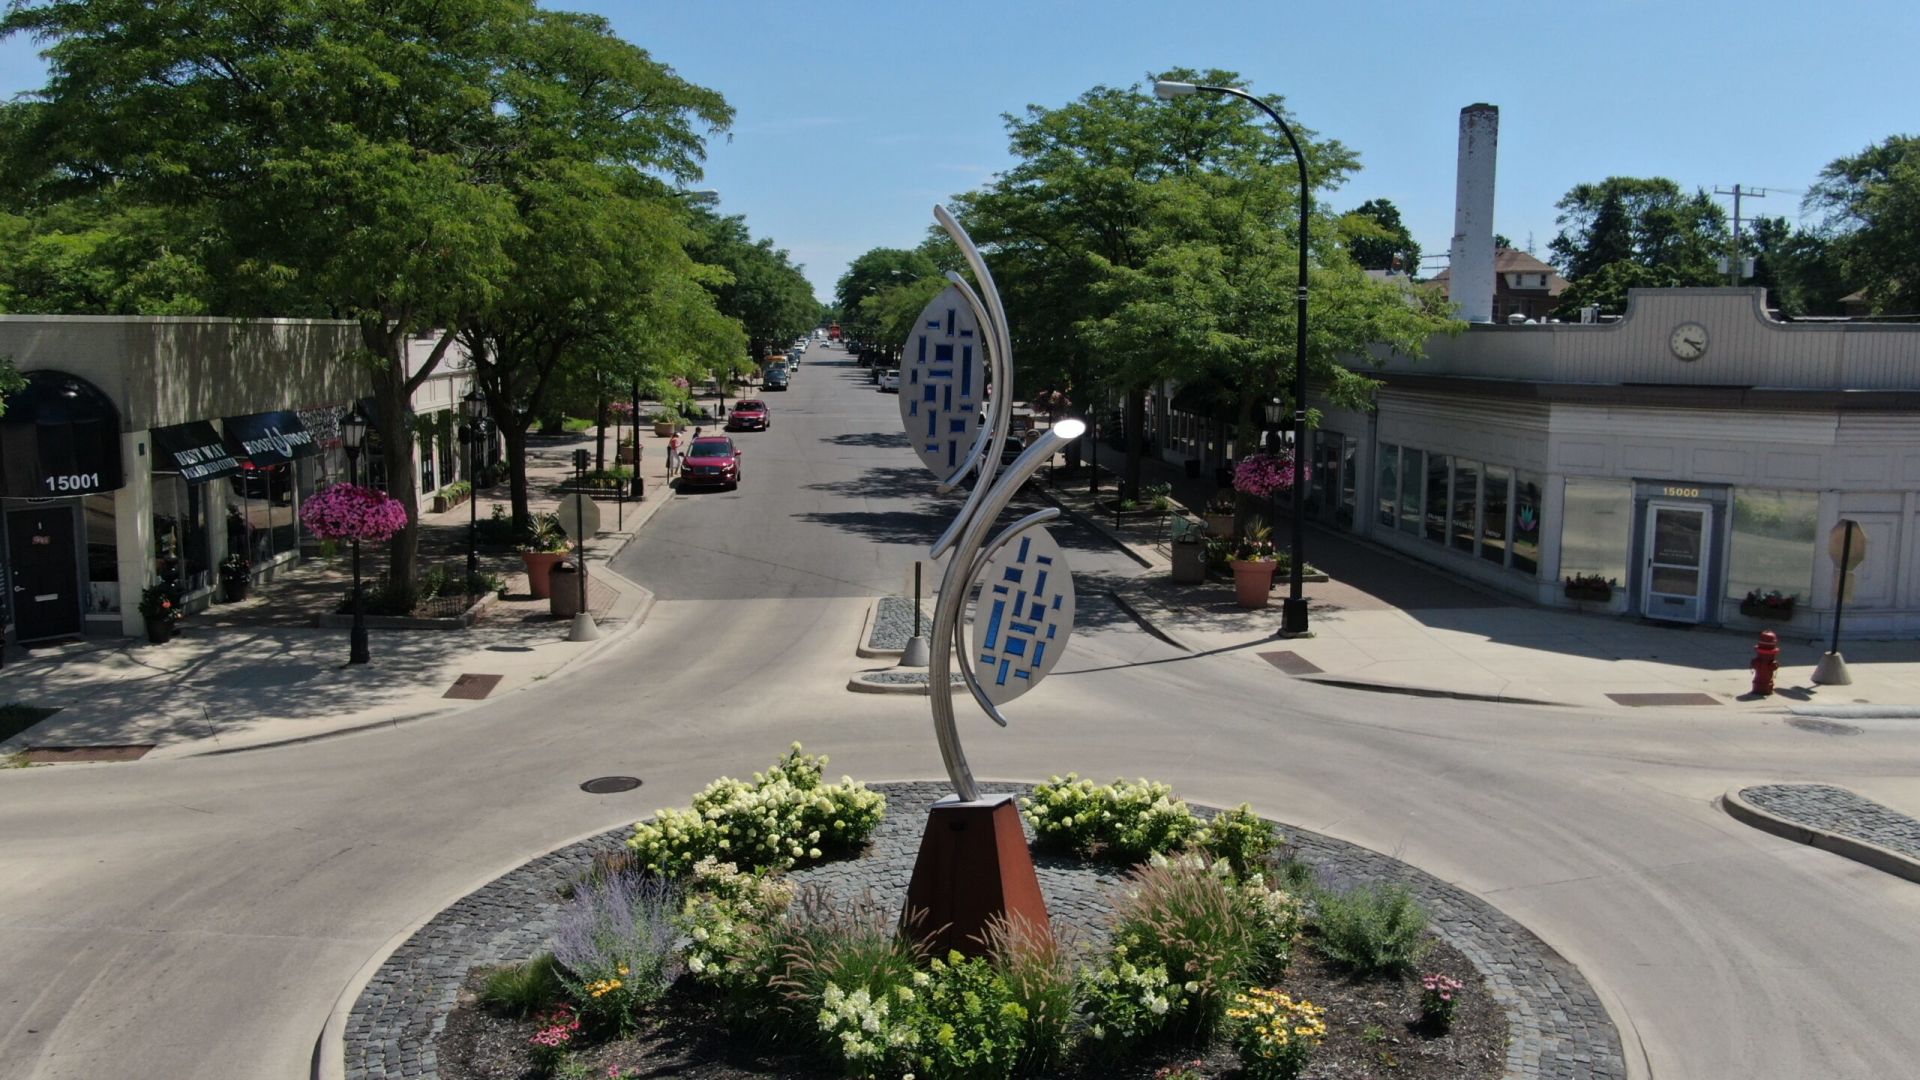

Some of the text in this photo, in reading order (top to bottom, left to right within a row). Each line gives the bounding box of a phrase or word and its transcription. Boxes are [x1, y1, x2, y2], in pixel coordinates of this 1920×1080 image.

[242, 438, 274, 455] HOOF
[283, 430, 312, 446] WOOF
[173, 443, 226, 466] BEST WAY
[45, 473, 99, 491] 15001
[1663, 487, 1699, 497] 15000
